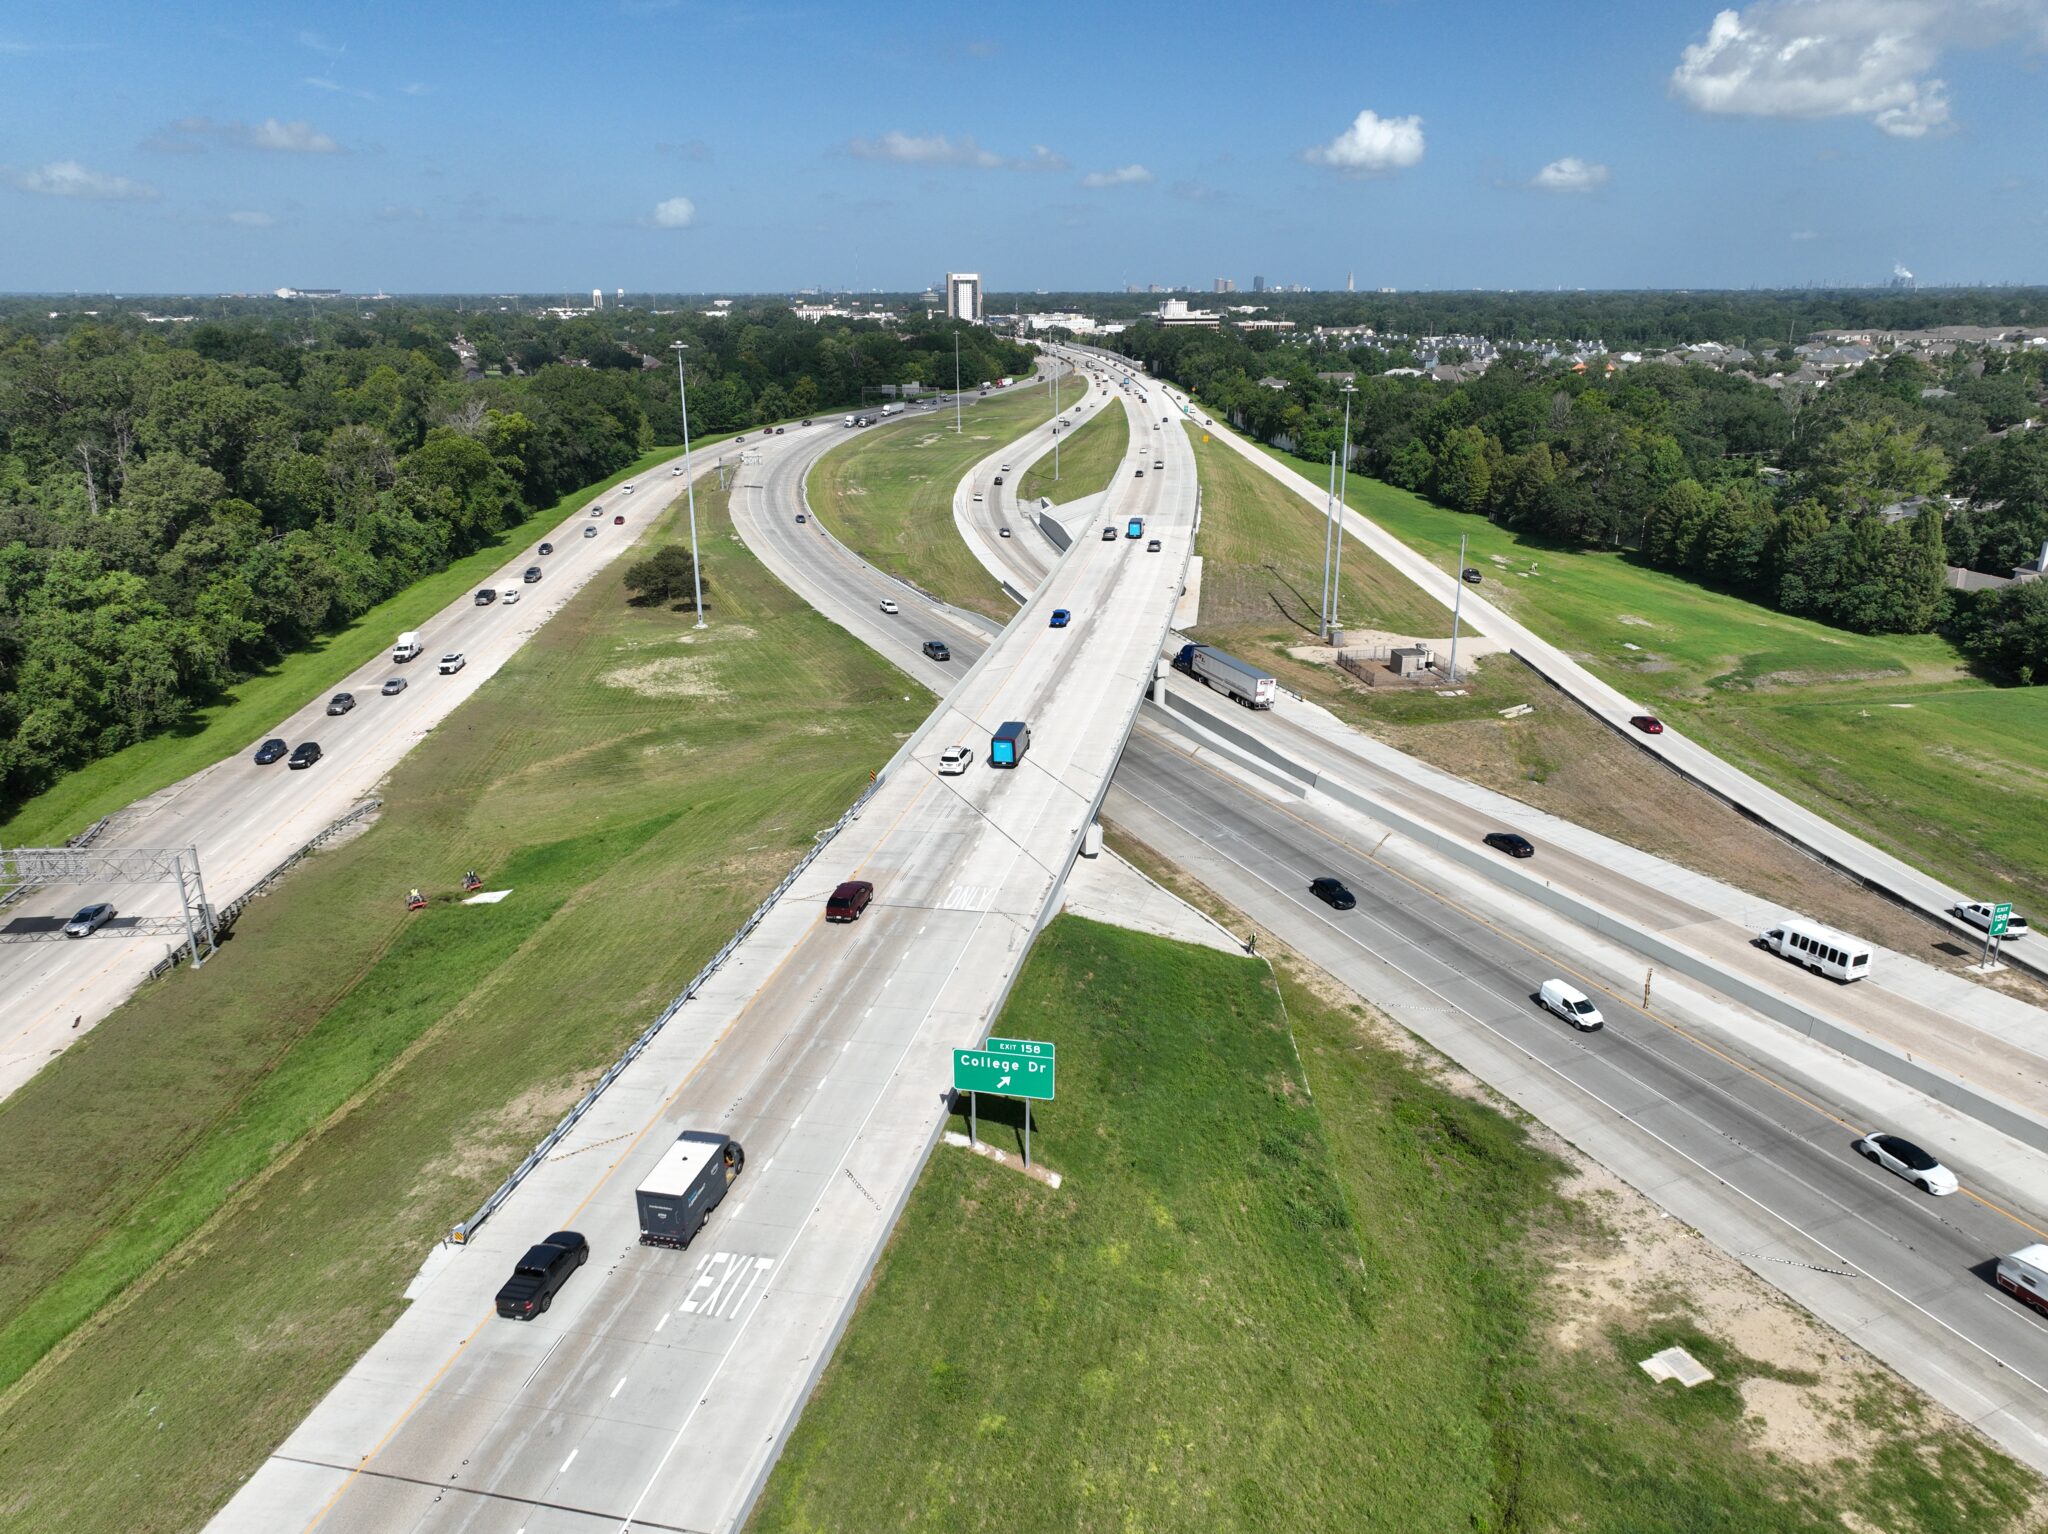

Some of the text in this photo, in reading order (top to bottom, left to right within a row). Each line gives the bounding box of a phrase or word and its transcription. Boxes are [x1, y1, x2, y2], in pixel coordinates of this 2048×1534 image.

[944, 886, 994, 911] ONLY
[1994, 914, 2008, 922] 158
[1000, 1043, 1041, 1054] EXIT 158
[960, 1054, 1047, 1073] College Dr
[678, 1252, 775, 1320] EXIT
